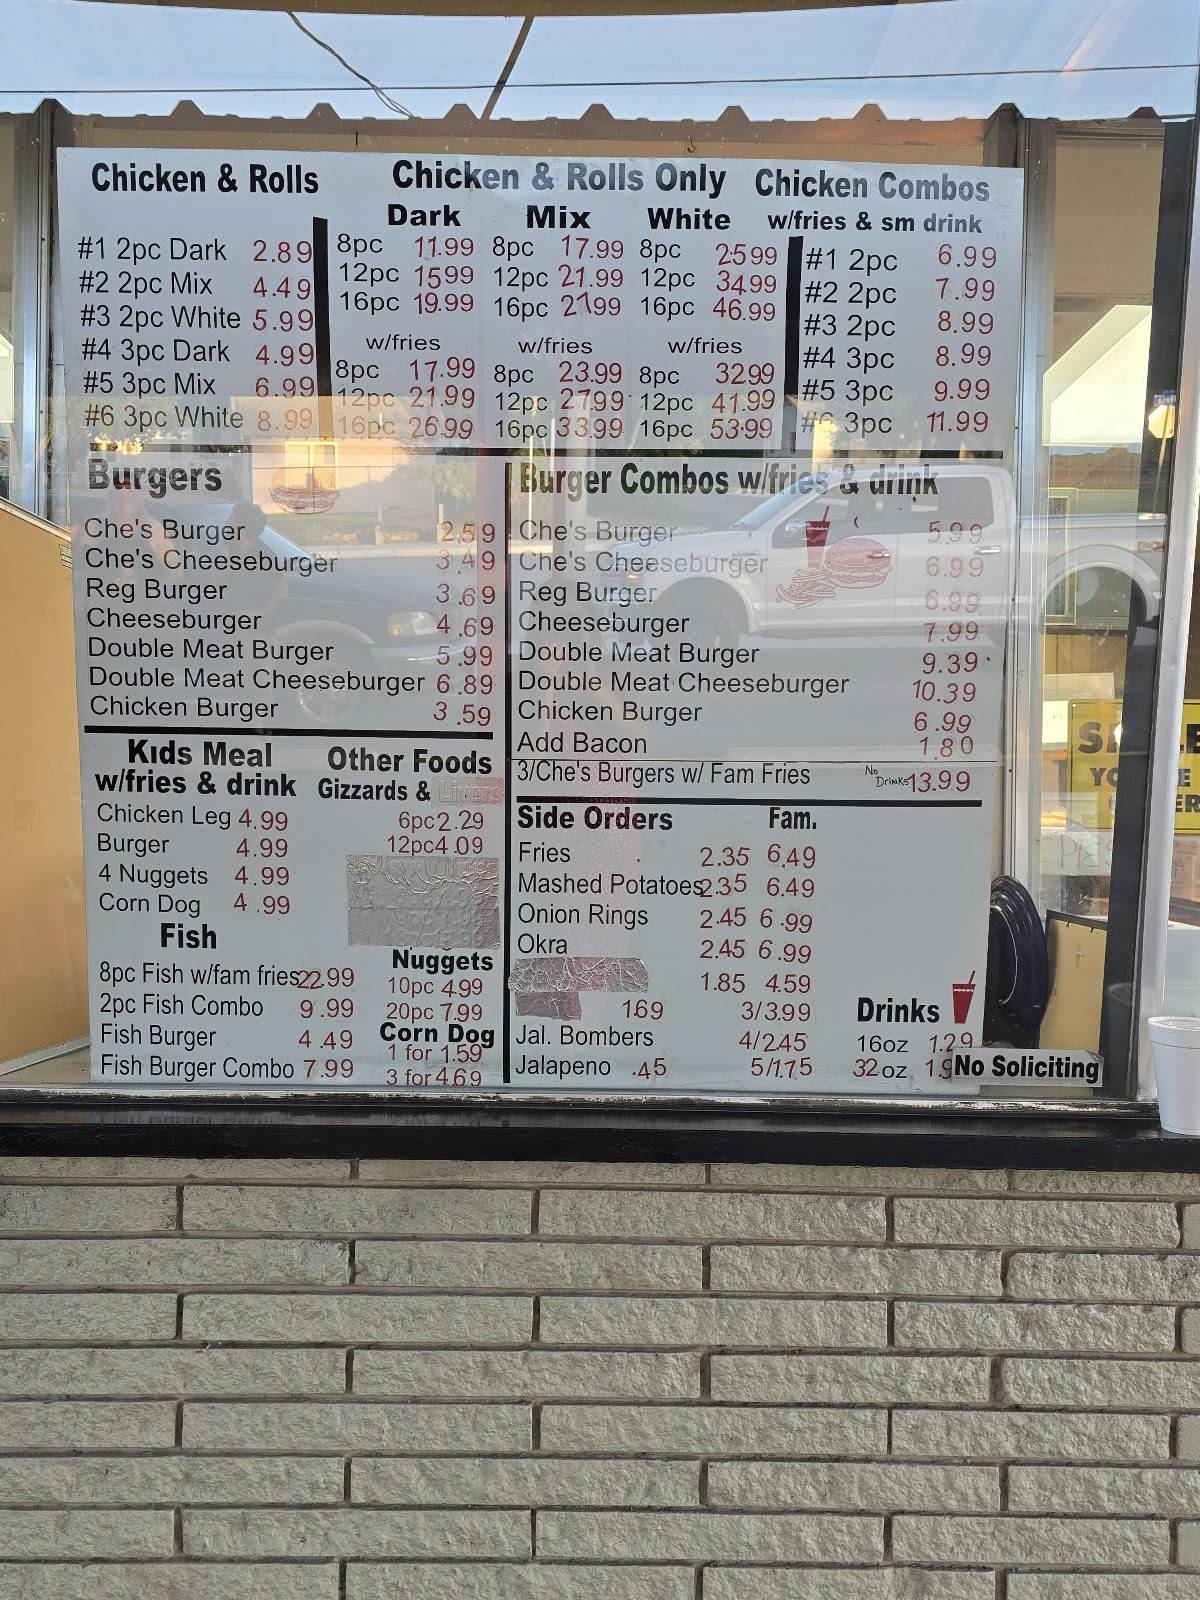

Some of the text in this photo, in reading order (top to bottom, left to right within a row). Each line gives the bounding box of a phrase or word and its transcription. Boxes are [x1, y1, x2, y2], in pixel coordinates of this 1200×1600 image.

[92, 163, 319, 193] Chicken & Rolls
[393, 160, 726, 199] Chicken & Rolls Only
[755, 168, 990, 201] Chicken Combos
[388, 204, 461, 227] Dark
[526, 205, 591, 229] Mix
[648, 208, 731, 230] White
[768, 210, 983, 234] w/fries sm drink
[78, 236, 227, 265] #1 2pc Dark
[253, 240, 312, 263] 2.89
[337, 234, 474, 258] 8pc 11.99
[492, 234, 624, 261] 8pc 17.99
[118, 272, 212, 299] 2pc Mix
[339, 263, 400, 286] 12pc
[494, 267, 548, 291] 12pc
[716, 271, 777, 296] 34.99
[253, 276, 311, 300] 4.49
[848, 283, 896, 308] 2pc
[936, 277, 995, 301] 7.99
[339, 291, 474, 315] 16pc 19.99
[495, 297, 549, 322] 16pc
[641, 297, 776, 321] 16pc 46.99
[171, 306, 241, 329] White
[82, 339, 230, 366] #4 3pc Dark
[366, 334, 440, 351] w/fries
[518, 338, 592, 354] w/fries
[668, 338, 742, 354] w/fries
[559, 361, 623, 384] 23.99
[123, 372, 216, 399] 3pc Mix
[409, 385, 475, 409] 21.99
[845, 380, 893, 406] 3pc
[934, 379, 990, 402] 9.99
[712, 389, 775, 414] 41.99
[85, 405, 243, 428] #6 White
[844, 412, 892, 438] 3pc
[927, 411, 989, 433] 11.99
[88, 459, 222, 498] Burgers
[519, 463, 939, 502] Burger Combos w/fries & drink
[84, 518, 245, 545] Che's Burger
[596, 521, 677, 546] Burger
[85, 548, 337, 576] Che's Cheeseburger
[87, 578, 227, 604] Reg Burger
[87, 608, 261, 634] Cheeseburger
[519, 612, 689, 637] Cheeseburger
[88, 637, 334, 665] Double Meat Burger
[437, 646, 493, 667] 5.99
[519, 642, 759, 668] Double Meat Burger
[922, 652, 977, 674] 9.39
[90, 667, 425, 695] Double Meat Cheeseburger
[436, 674, 493, 695] 6.89
[519, 672, 849, 698] Double Cheeseburger
[90, 696, 278, 722] Chicken Burger
[519, 701, 702, 726] Chicken Burger
[517, 732, 647, 753] Add Bacon
[203, 742, 272, 768] Meal
[328, 746, 492, 775] Other Foods
[95, 769, 296, 797] w/fries drink
[517, 760, 810, 787] 3/Che's Burgers Fam Fries
[907, 770, 970, 793] 13.99
[318, 777, 407, 802] Gizzards
[98, 803, 231, 830] Chicken Leg
[238, 808, 288, 831] 4.99
[399, 811, 434, 833] 6pc
[438, 810, 484, 832] 2.29
[518, 805, 673, 830] Side Orders
[769, 807, 817, 830] Fam.
[97, 833, 169, 856] Burger
[236, 838, 288, 858] 4.99
[519, 843, 570, 863] Fries
[767, 844, 816, 868] 6.49
[701, 847, 750, 867] 2.35
[120, 865, 208, 888] Nuggets
[519, 873, 703, 895] Mashed Potatoes
[100, 894, 200, 918] Corn Dog
[518, 903, 579, 924] Onion
[589, 904, 648, 930] Rings
[700, 907, 746, 928] 2.45
[160, 923, 217, 950] Fish
[518, 934, 567, 954] Okra
[392, 949, 493, 974] Nuggets
[100, 962, 299, 986] 8pc Fish w/fam fries
[701, 973, 745, 993] 1.85
[766, 974, 810, 993] 4.59
[388, 977, 434, 997] 10pc
[192, 995, 263, 1017] Combo
[386, 1002, 433, 1023] 20pc
[741, 1001, 810, 1021] 3/3.99
[857, 997, 940, 1023] Drinks
[101, 1024, 141, 1045] Fish
[380, 1023, 495, 1047] Corn Dog
[516, 1025, 654, 1047] Jal. Bombers
[857, 1035, 908, 1052] 16oz
[405, 1044, 482, 1063] for 1.59
[516, 1055, 610, 1079] Jalapeno
[853, 1059, 907, 1078] 32oz
[955, 1055, 1099, 1084] No Soliciting
